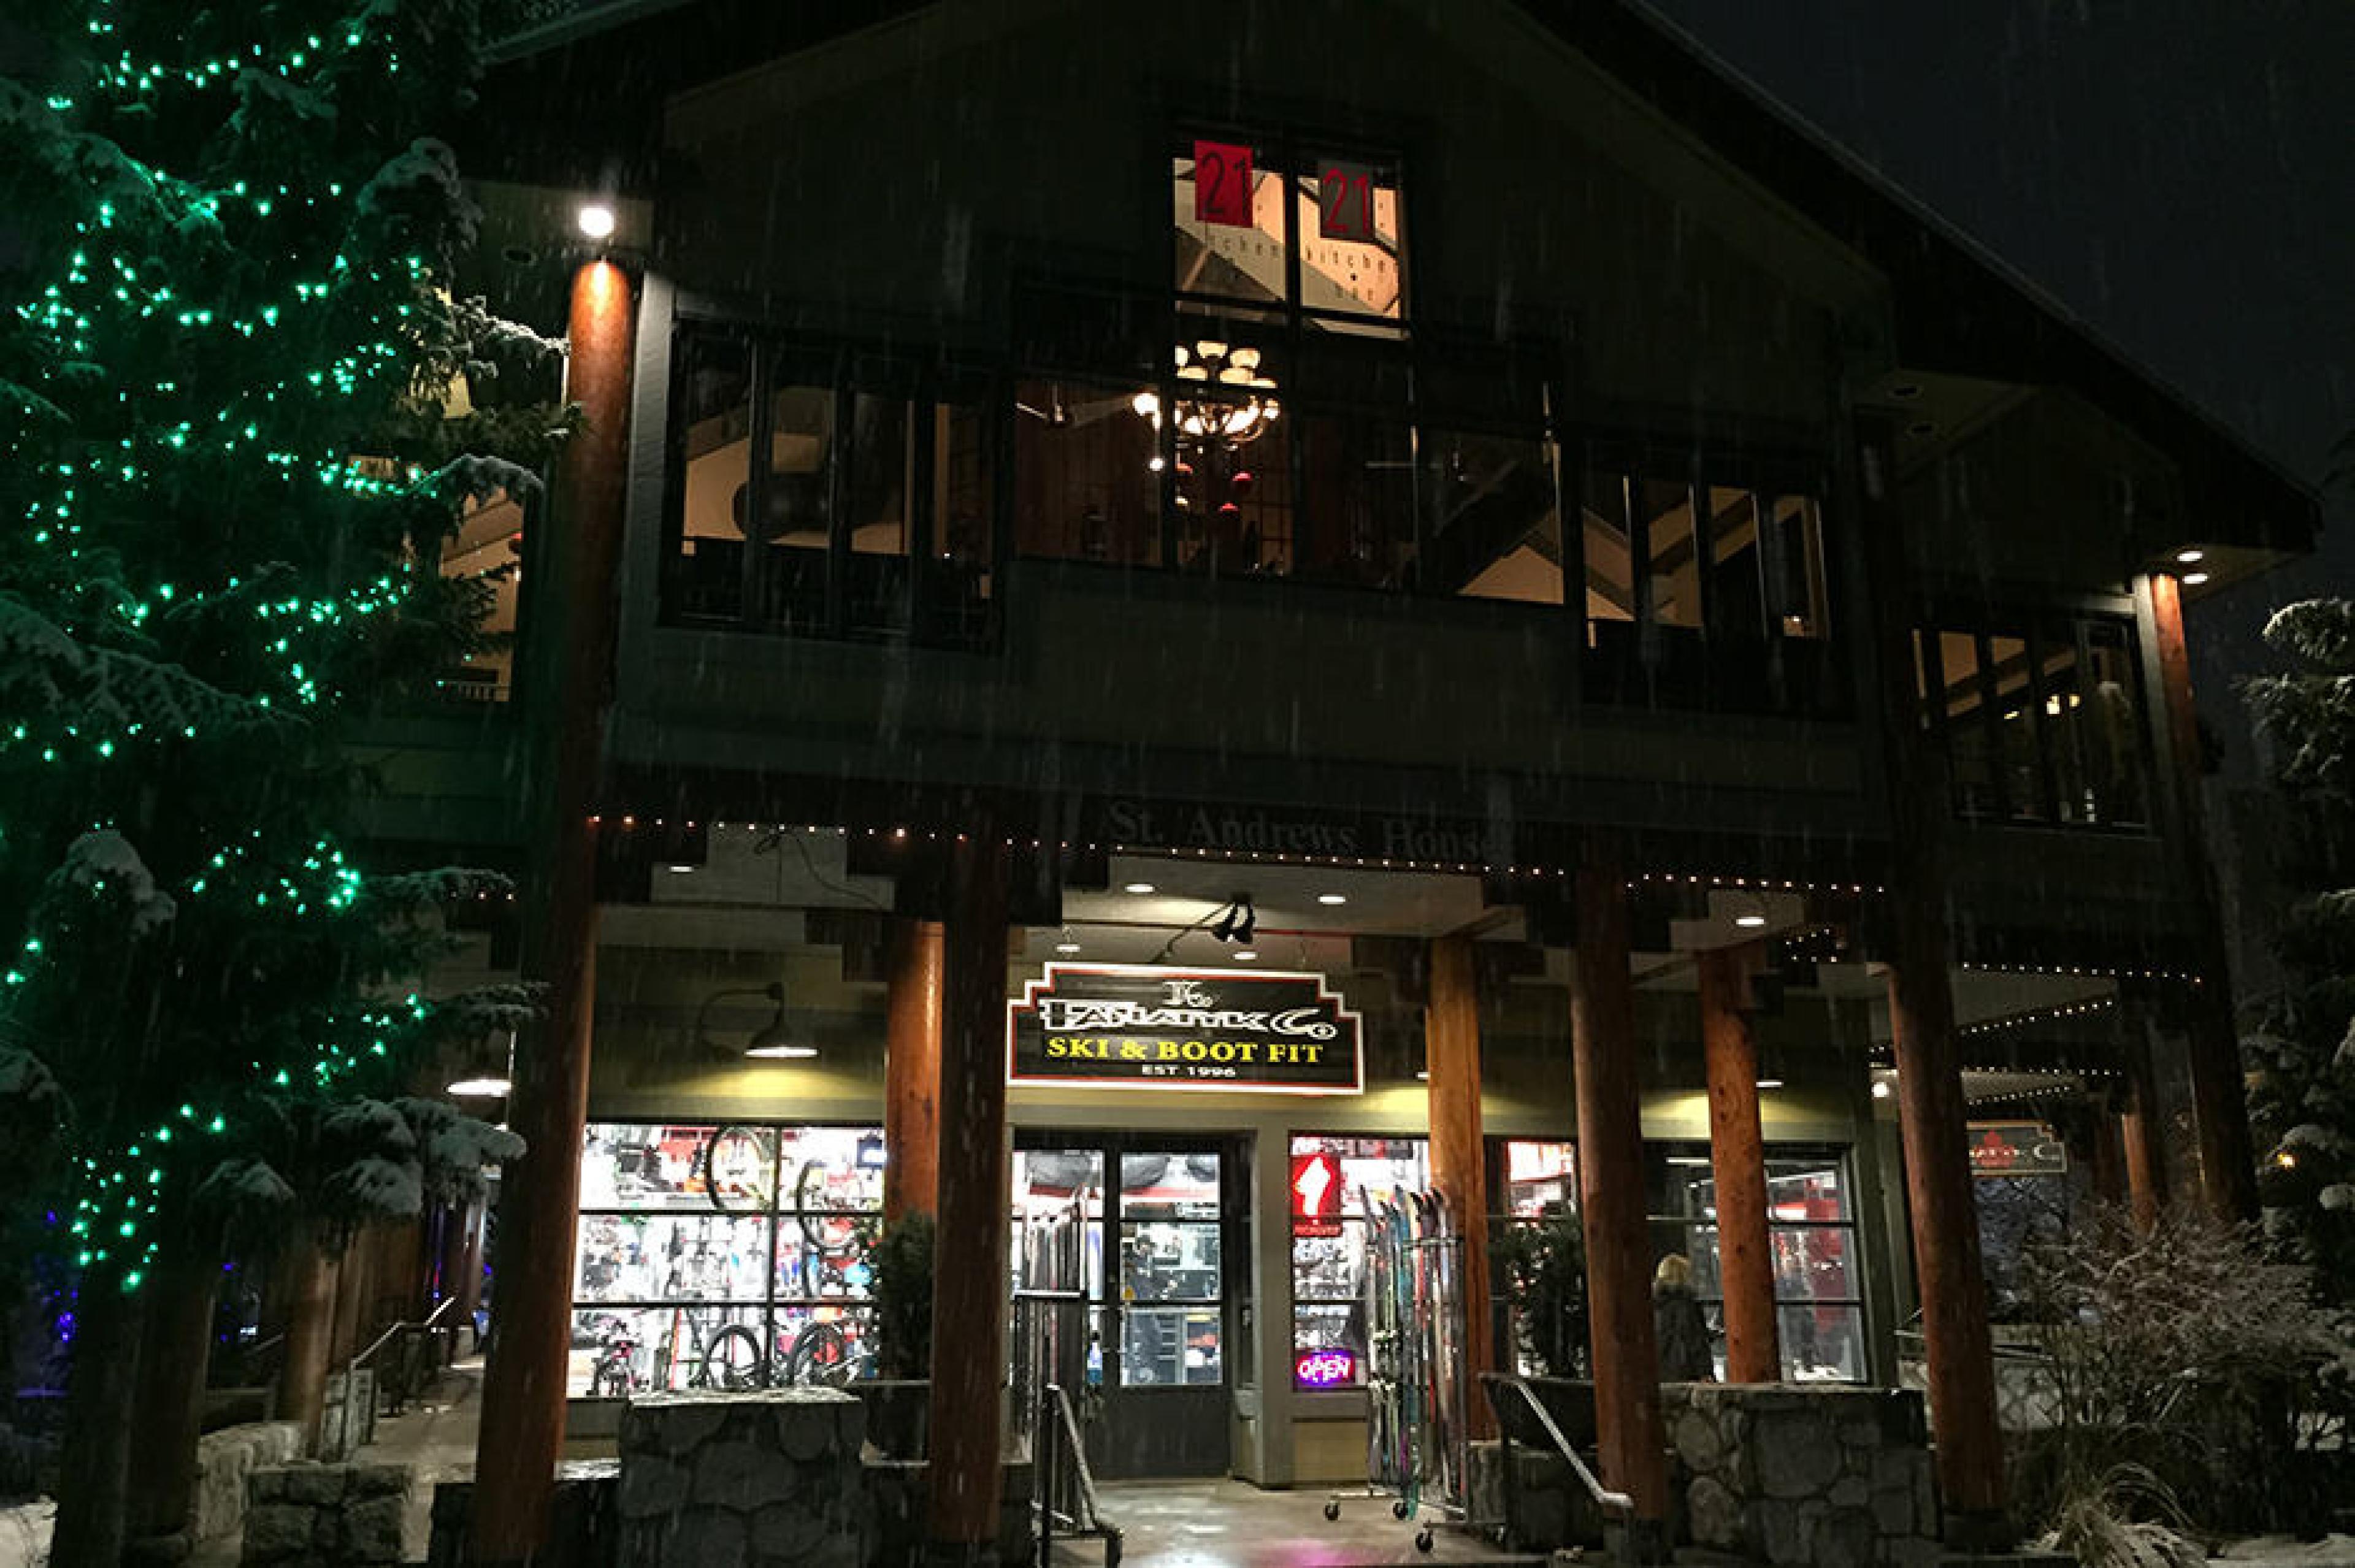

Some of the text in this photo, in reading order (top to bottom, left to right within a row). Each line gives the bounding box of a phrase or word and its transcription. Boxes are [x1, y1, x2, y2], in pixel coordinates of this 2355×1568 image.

[1200, 151, 1249, 222] 21
[1323, 168, 1369, 234] 21
[1187, 804, 1358, 853] Andrews
[1047, 1038, 1323, 1064] SKI & BOOT FIT
[1141, 1065, 1178, 1076] EST
[1298, 1355, 1350, 1383] OPEN
